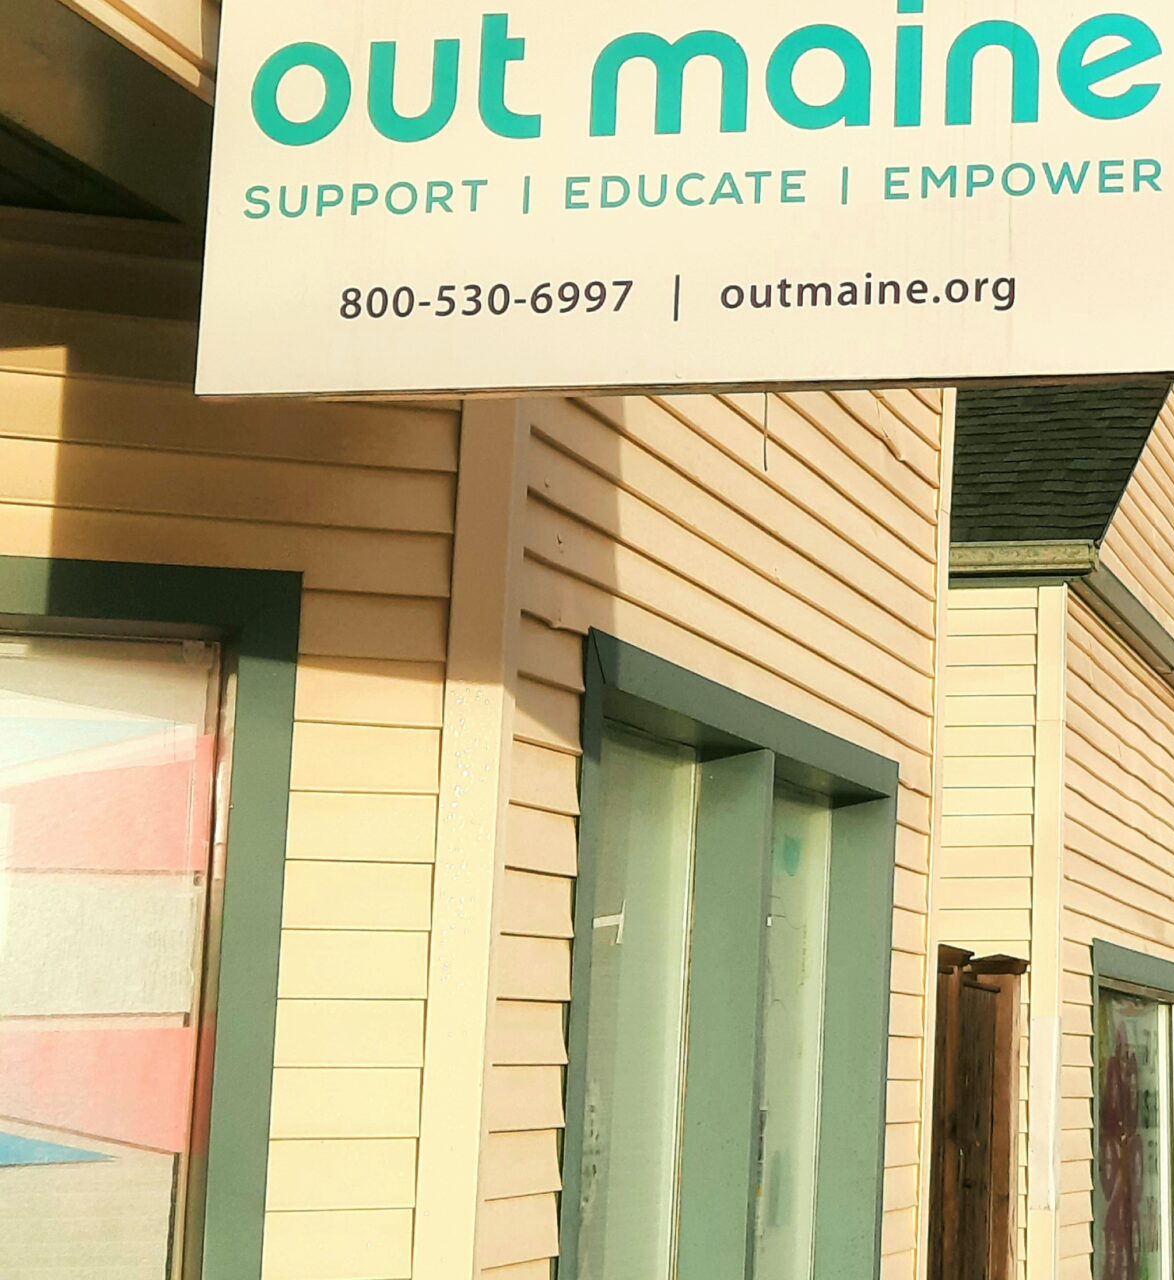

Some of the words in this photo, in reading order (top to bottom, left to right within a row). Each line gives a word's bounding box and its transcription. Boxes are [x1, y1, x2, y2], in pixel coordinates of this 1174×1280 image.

[251, 13, 541, 146] out
[243, 179, 488, 219] SUPPORT
[564, 170, 806, 209] EDUCATE
[884, 159, 1162, 200] EMPOWER
[339, 280, 633, 319] 800-530-6997
[720, 272, 1016, 311] outmaine.org
